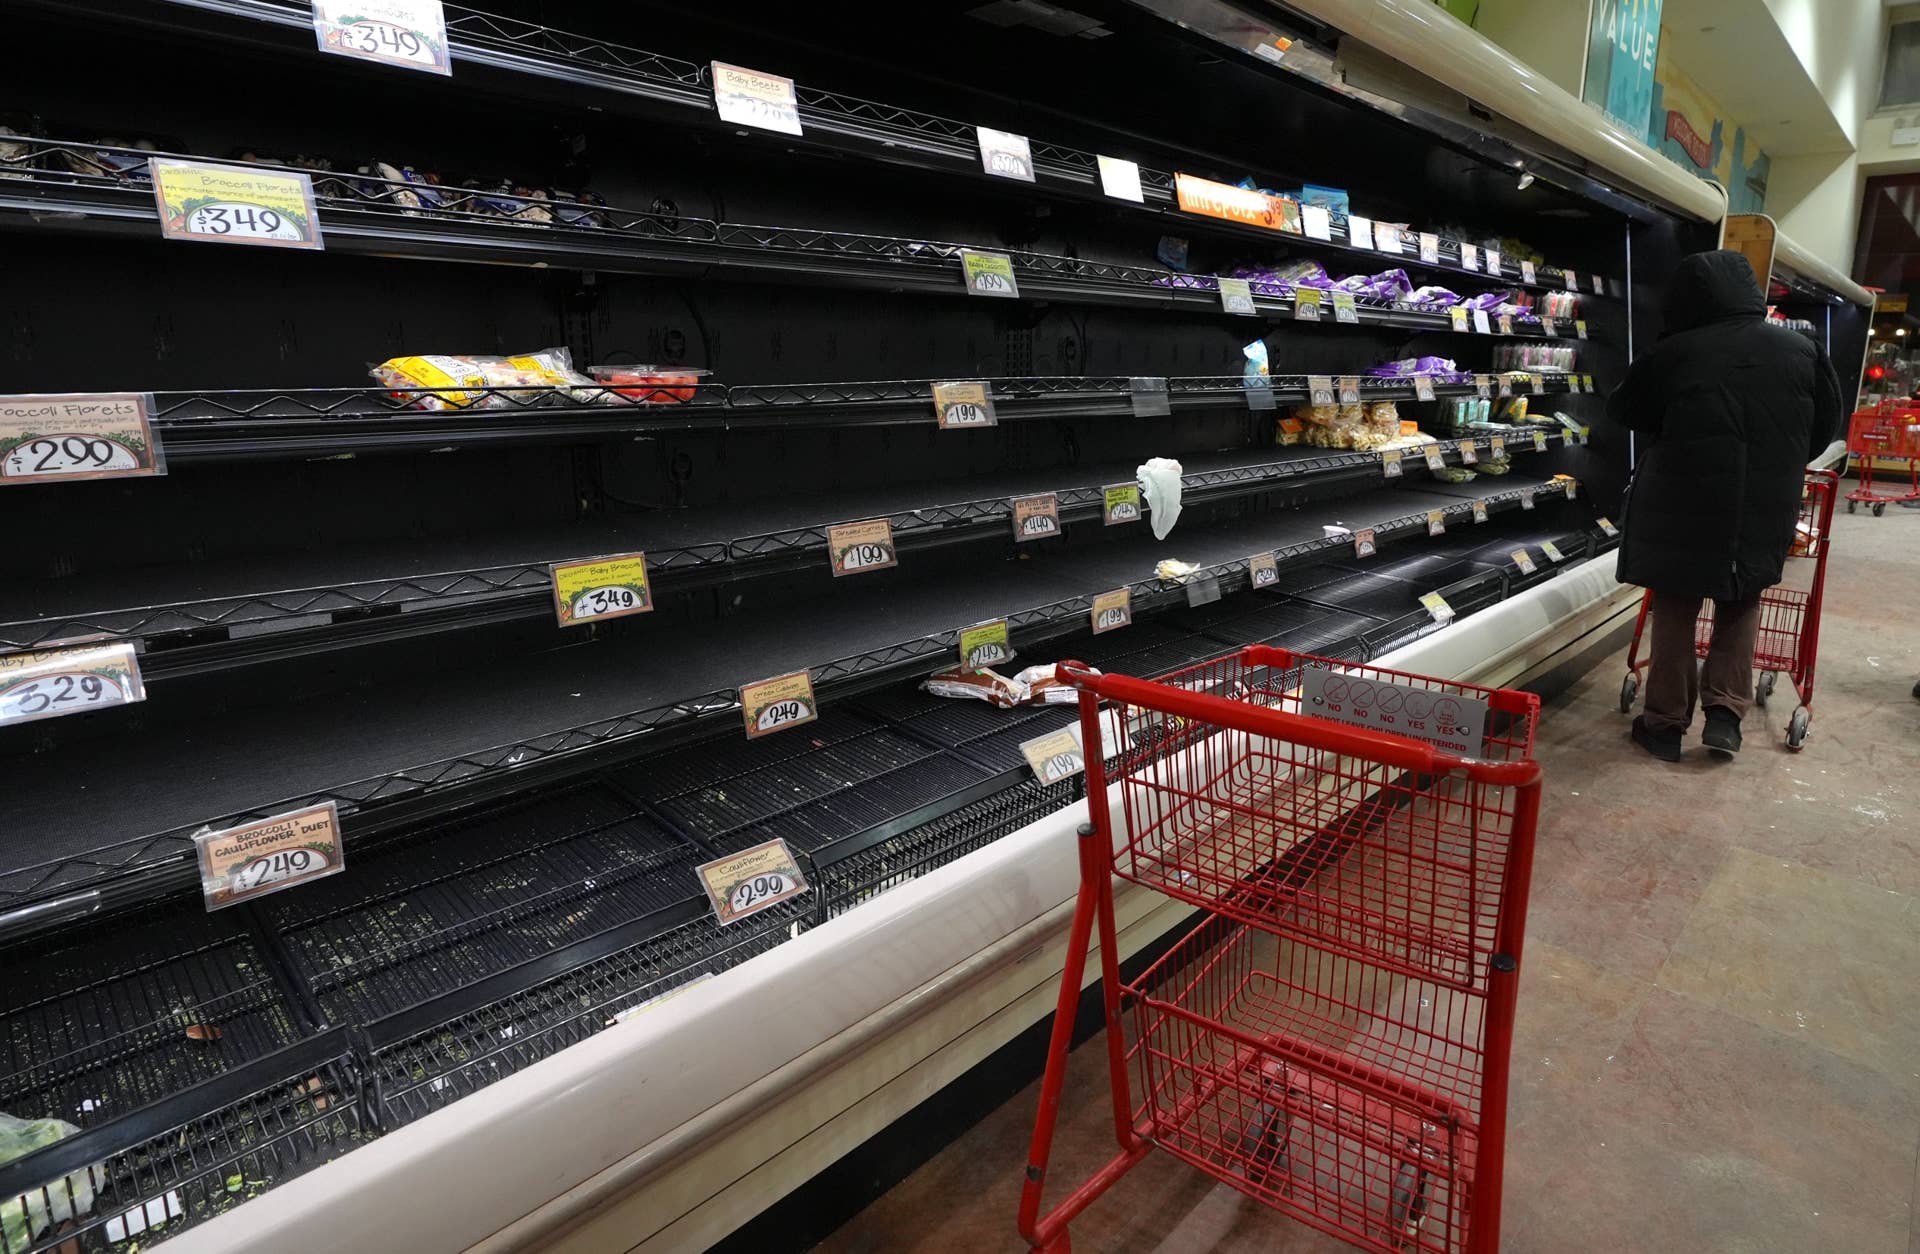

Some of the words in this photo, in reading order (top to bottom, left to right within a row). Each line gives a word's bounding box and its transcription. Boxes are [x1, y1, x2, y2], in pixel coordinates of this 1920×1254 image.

[1600, 0, 1655, 71] VALUE
[726, 71, 749, 88] Baby
[752, 76, 780, 91] Beets
[200, 175, 252, 189] Broccoli
[256, 182, 302, 194] Florets
[63, 403, 135, 417] Florets
[590, 565, 609, 575] Baby
[1327, 703, 1342, 713] NO
[1353, 708, 1368, 718] NO
[1380, 713, 1395, 724] NO
[1407, 719, 1425, 730] YES
[1436, 725, 1455, 736] YES
[214, 830, 295, 857] CAULIFLOWER
[300, 820, 329, 834] DUET
[236, 822, 291, 843] BROCCOLI
[720, 850, 770, 875] Cauliflower
